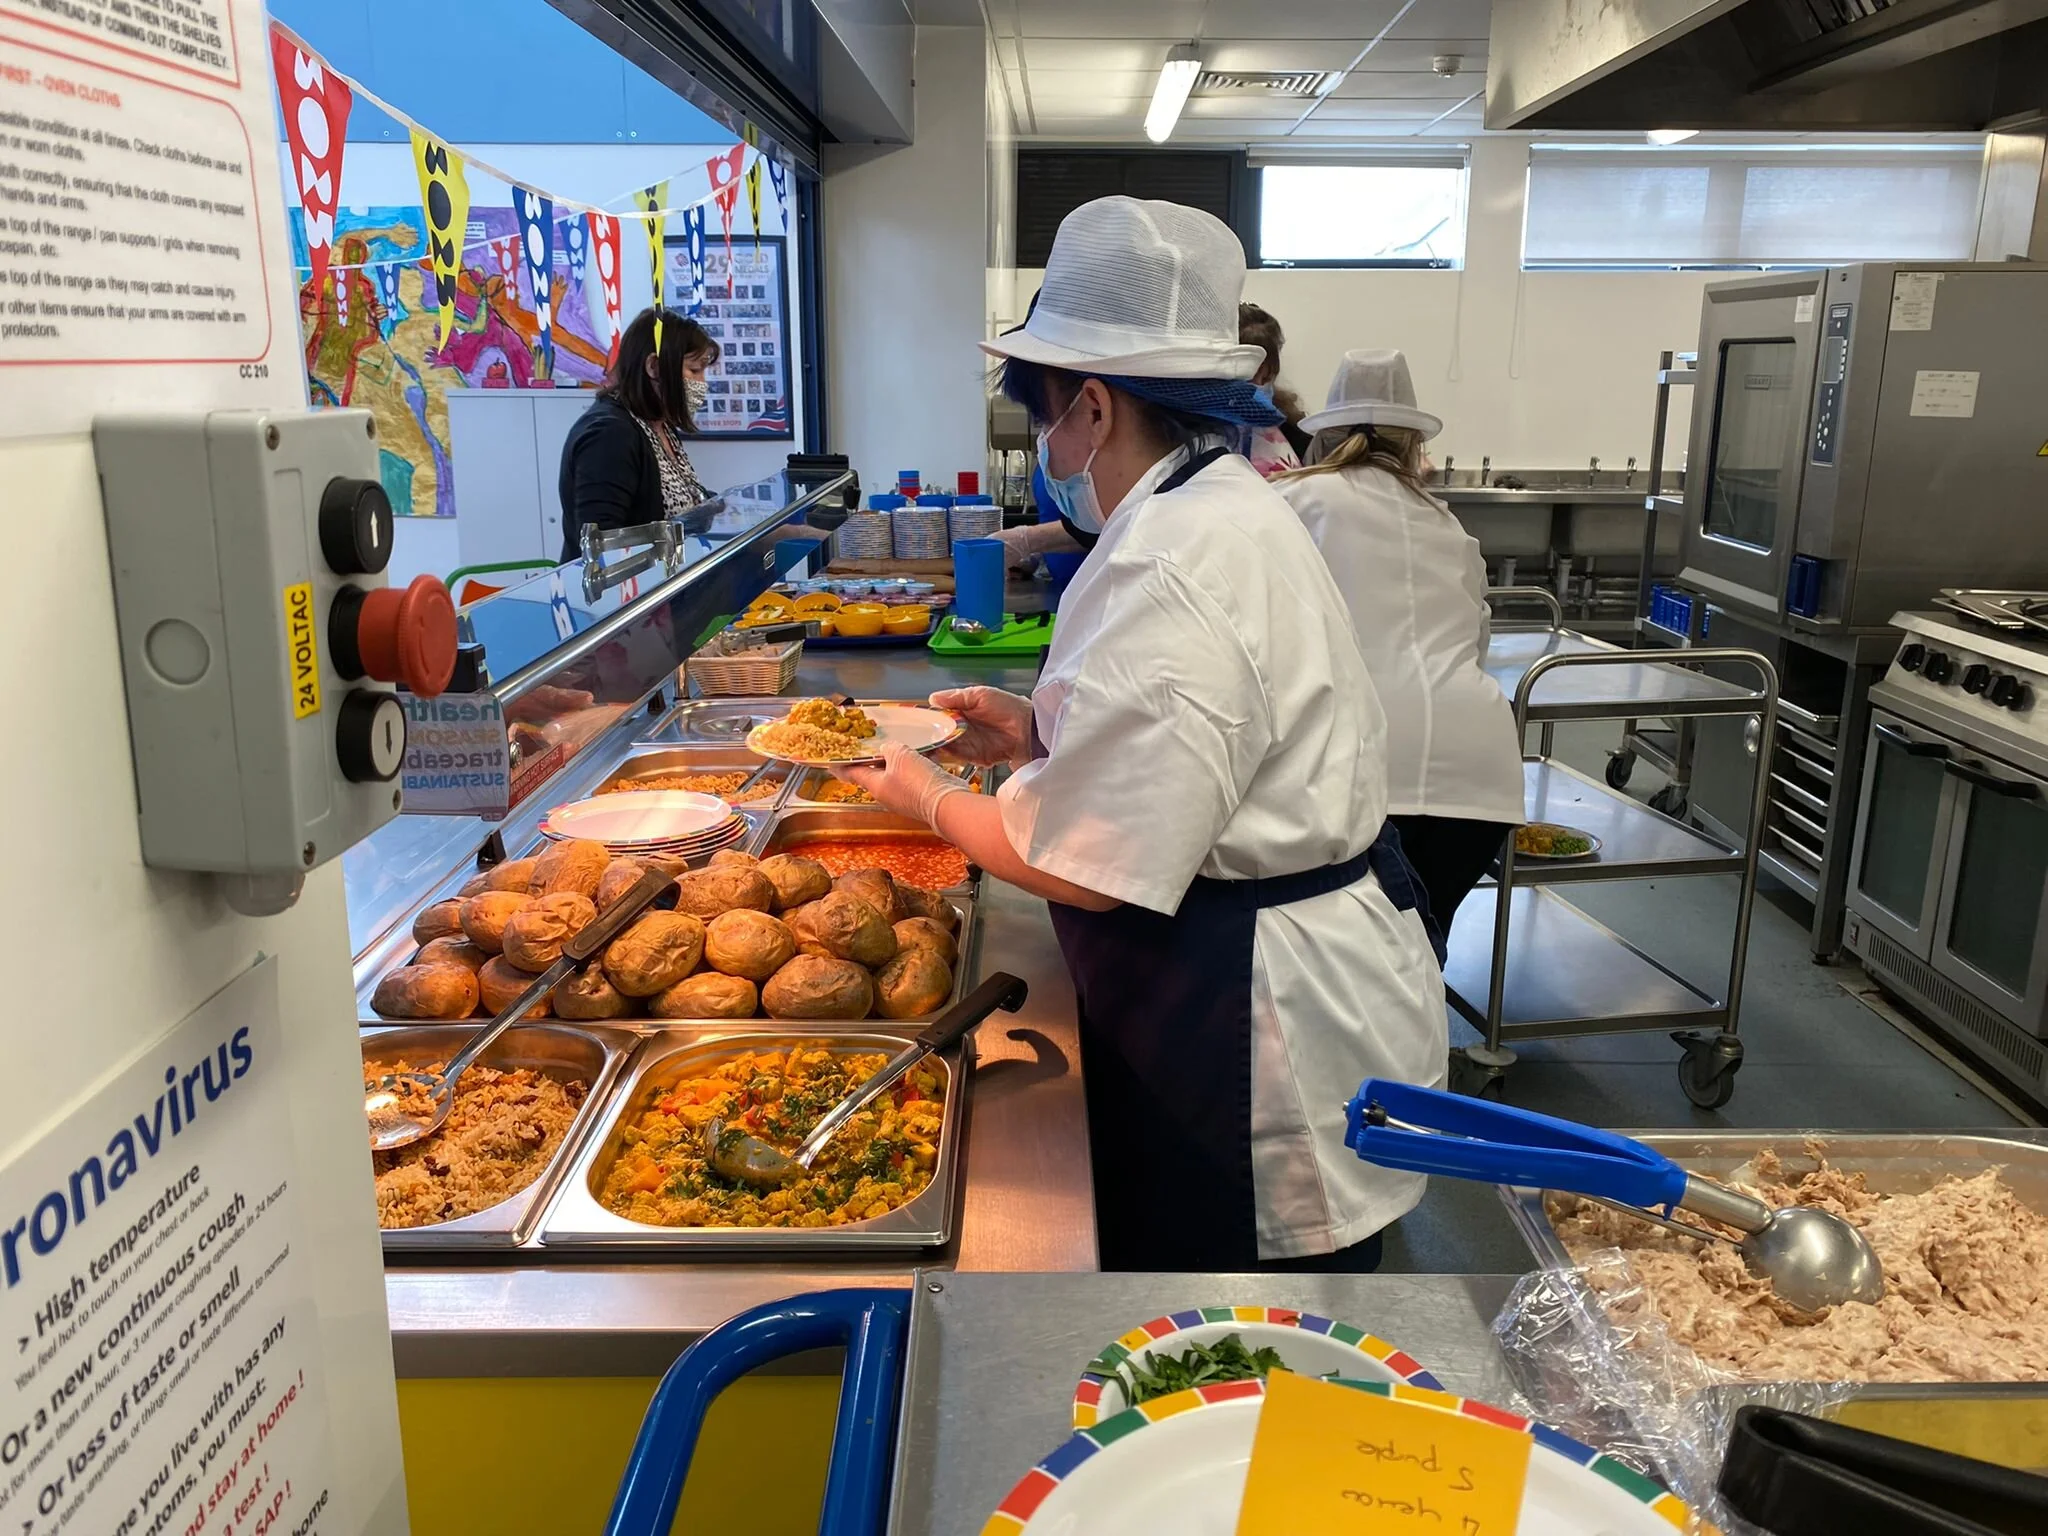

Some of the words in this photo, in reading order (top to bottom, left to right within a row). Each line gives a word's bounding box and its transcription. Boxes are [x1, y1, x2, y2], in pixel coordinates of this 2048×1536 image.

[88, 10, 102, 27] OF
[105, 16, 145, 42] COMING
[147, 30, 167, 49] OUT
[134, 5, 160, 27] THEN
[161, 16, 180, 34] THE
[182, 23, 222, 49] SHELVES
[176, 2, 199, 23] PULL
[201, 12, 218, 30] THE
[78, 83, 121, 108] CLOTHS
[32, 118, 78, 139] condition
[228, 161, 242, 175] and
[38, 192, 57, 207] and
[73, 177, 113, 198] ensuring
[10, 217, 27, 236] top
[31, 218, 40, 236] of
[43, 220, 60, 237] the
[63, 225, 92, 243] range
[101, 229, 118, 244] pan
[119, 231, 157, 247] supports
[10, 270, 27, 288] top
[31, 270, 41, 287] of
[44, 271, 61, 287] the
[63, 275, 93, 293] range
[95, 278, 107, 290] as
[109, 277, 128, 295] they
[130, 279, 149, 296] may
[175, 282, 190, 297] and
[1, 323, 60, 341] protectors.
[8, 300, 36, 315] other
[40, 301, 67, 317] items
[71, 304, 105, 318] ensure
[107, 304, 125, 318] that
[127, 306, 146, 322] your
[148, 307, 169, 320] arms
[171, 308, 184, 321] are
[186, 309, 215, 322] covered
[239, 363, 252, 379] CC
[254, 364, 269, 379] 210
[291, 590, 312, 680] VOLTAC
[300, 682, 316, 709] 24
[35, 1274, 86, 1338] High
[89, 1165, 200, 1283] temperature
[15, 1365, 36, 1391] You
[38, 1340, 57, 1371] feel
[59, 1321, 76, 1349] hot
[79, 1310, 89, 1327] to
[91, 1279, 119, 1316] touch
[120, 1265, 132, 1284] on
[133, 1243, 154, 1274] your
[155, 1215, 178, 1248] chest
[179, 1205, 190, 1223] or
[190, 1186, 210, 1214] back
[1, 1422, 30, 1464] Or
[35, 1408, 47, 1432] a
[51, 1354, 93, 1413] new
[98, 1246, 195, 1360] continuous
[198, 1192, 245, 1252] cough
[27, 1439, 54, 1475] more
[55, 1409, 80, 1440] than
[80, 1392, 94, 1413] an
[95, 1363, 120, 1394] hour,
[121, 1350, 131, 1367] or
[133, 1337, 140, 1353] 3
[141, 1327, 151, 1345] or
[151, 1301, 174, 1334] more
[175, 1260, 213, 1306] coughing
[212, 1223, 246, 1265] episodes
[246, 1214, 254, 1228] in
[255, 1201, 267, 1219] 24
[266, 1180, 288, 1206] hours
[86, 1438, 130, 1493] anything,
[130, 1422, 141, 1438] or
[141, 1389, 168, 1425] things
[168, 1356, 190, 1392] smell
[191, 1349, 200, 1365] or
[201, 1326, 221, 1353] taste
[222, 1284, 254, 1328] different
[255, 1275, 263, 1290] to
[264, 1242, 290, 1280] normal
[38, 1475, 65, 1516] Or
[67, 1428, 106, 1483] loss
[110, 1392, 128, 1432] of
[132, 1346, 175, 1405] taste
[179, 1319, 197, 1350] or
[199, 1264, 240, 1328] smell
[139, 1463, 170, 1515] you
[171, 1426, 199, 1470] live
[200, 1381, 235, 1430] with
[235, 1349, 260, 1387] has
[262, 1315, 286, 1355] any
[198, 1429, 227, 1477] you
[228, 1377, 267, 1435] must:
[207, 1459, 238, 1514] stay
[240, 1436, 257, 1467] at
[256, 1383, 297, 1443] home
[234, 1477, 262, 1525] test
[1449, 1466, 1475, 1492] 5
